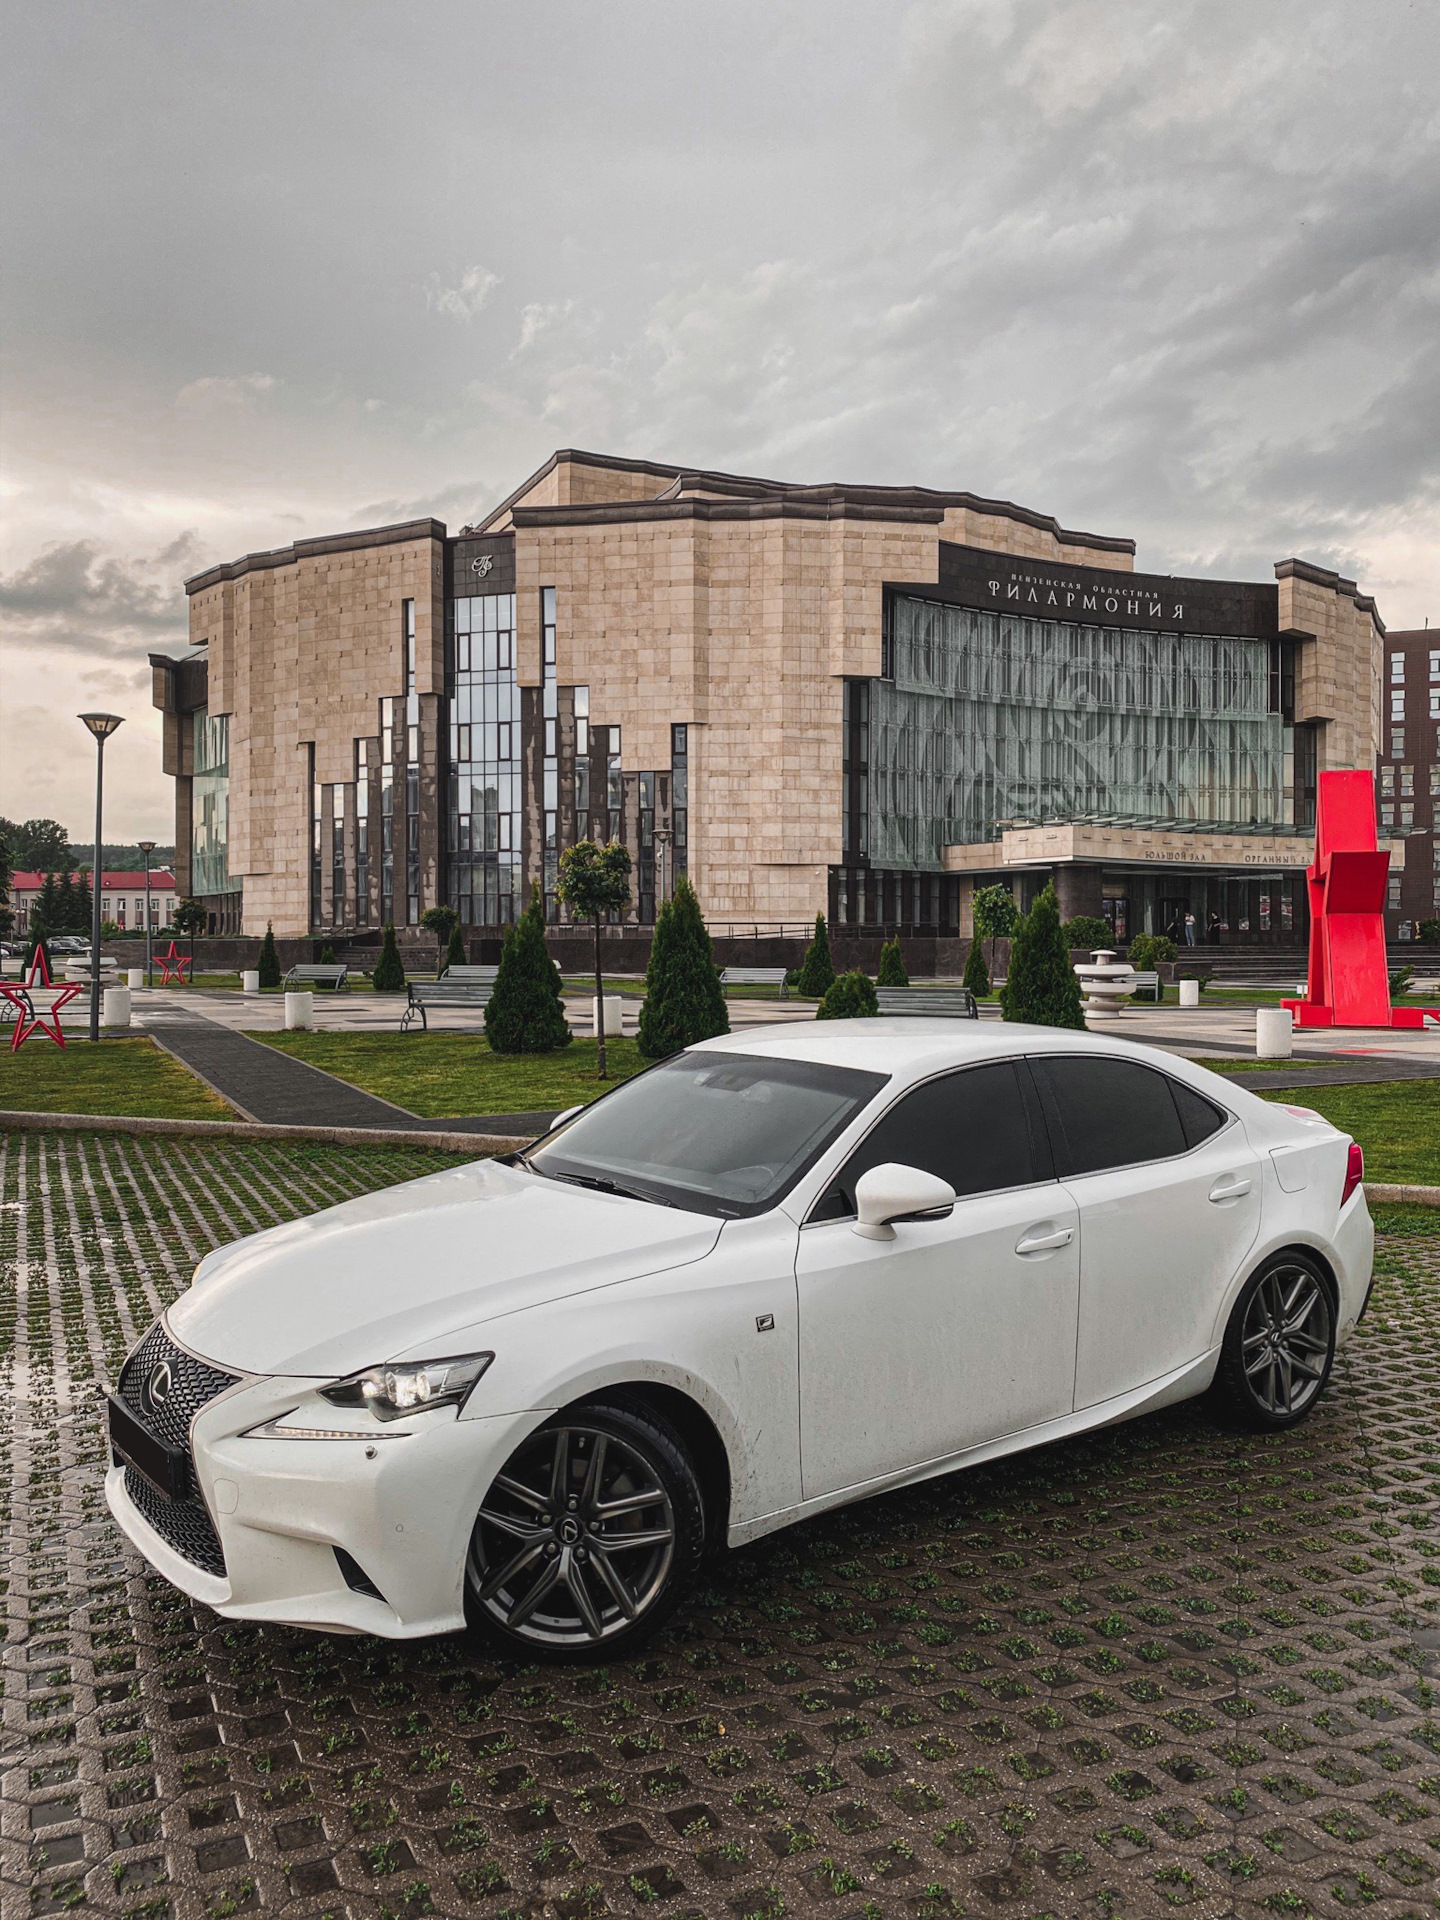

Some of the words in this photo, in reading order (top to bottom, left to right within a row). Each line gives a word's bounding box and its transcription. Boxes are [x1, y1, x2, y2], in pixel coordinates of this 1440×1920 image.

[1011, 573, 1081, 590] ПЕНЗЕНСКАЯ
[1092, 585, 1158, 599] ОБЛАСТНАЯ
[988, 580, 1184, 619] ФИЛАРМОНИЯ
[1145, 850, 1187, 860] БОЛЬШОЙ
[1245, 854, 1296, 864] ОРГАННЫЙ
